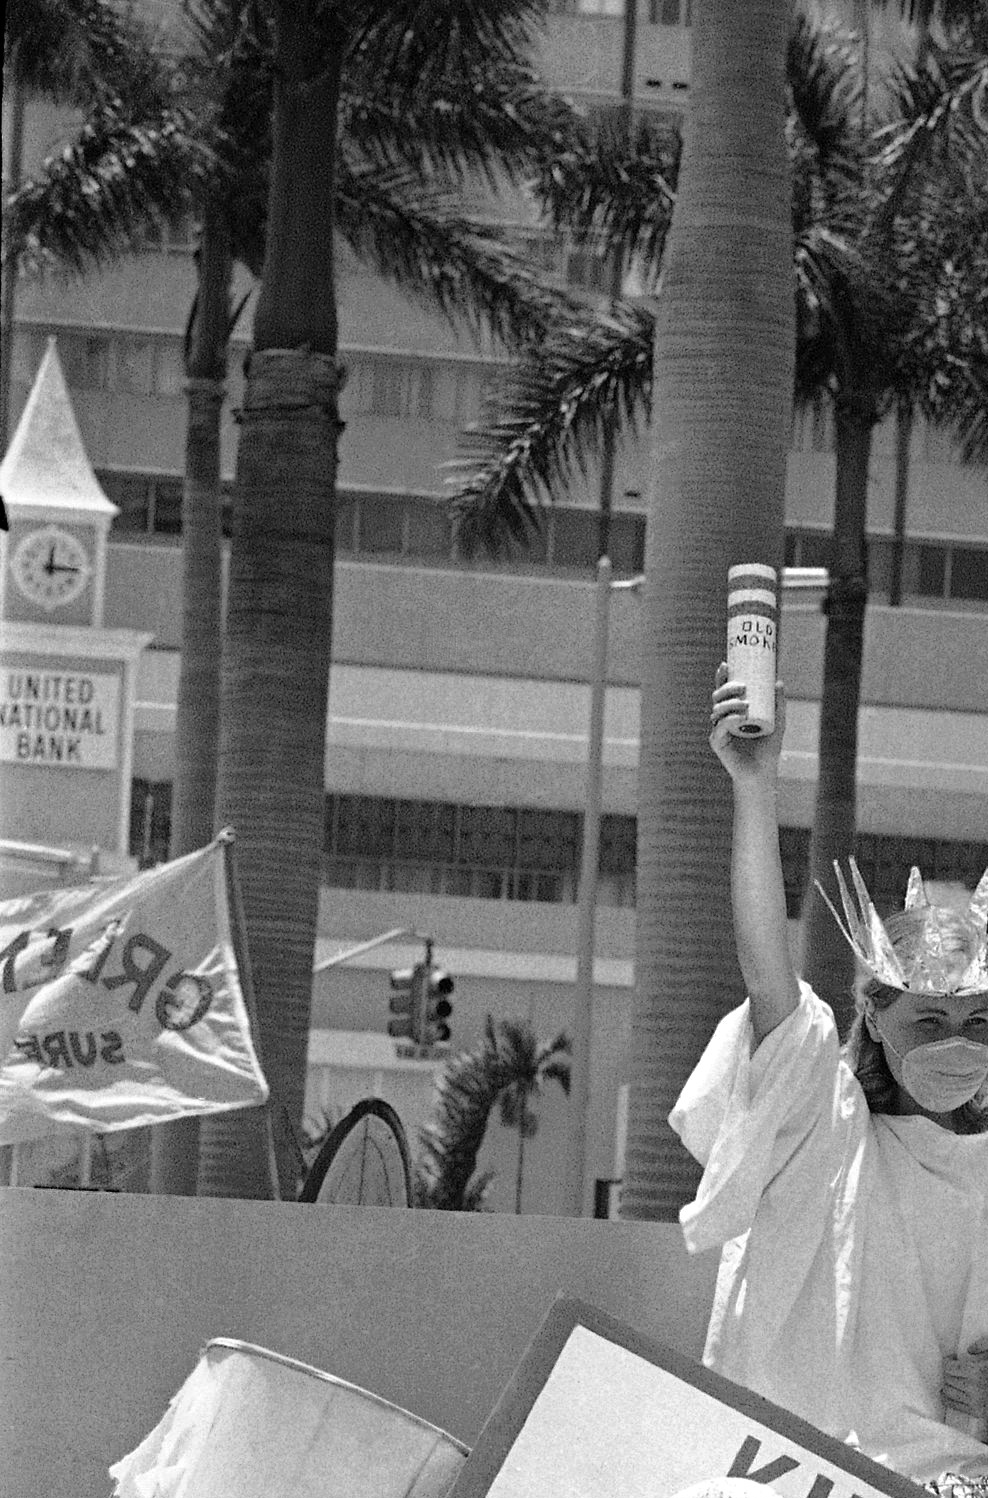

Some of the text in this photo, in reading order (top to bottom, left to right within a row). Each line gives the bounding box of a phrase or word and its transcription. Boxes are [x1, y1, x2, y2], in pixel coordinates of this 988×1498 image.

[742, 621, 772, 636] OLD
[8, 674, 94, 704] UNITED
[17, 732, 81, 760] BANK
